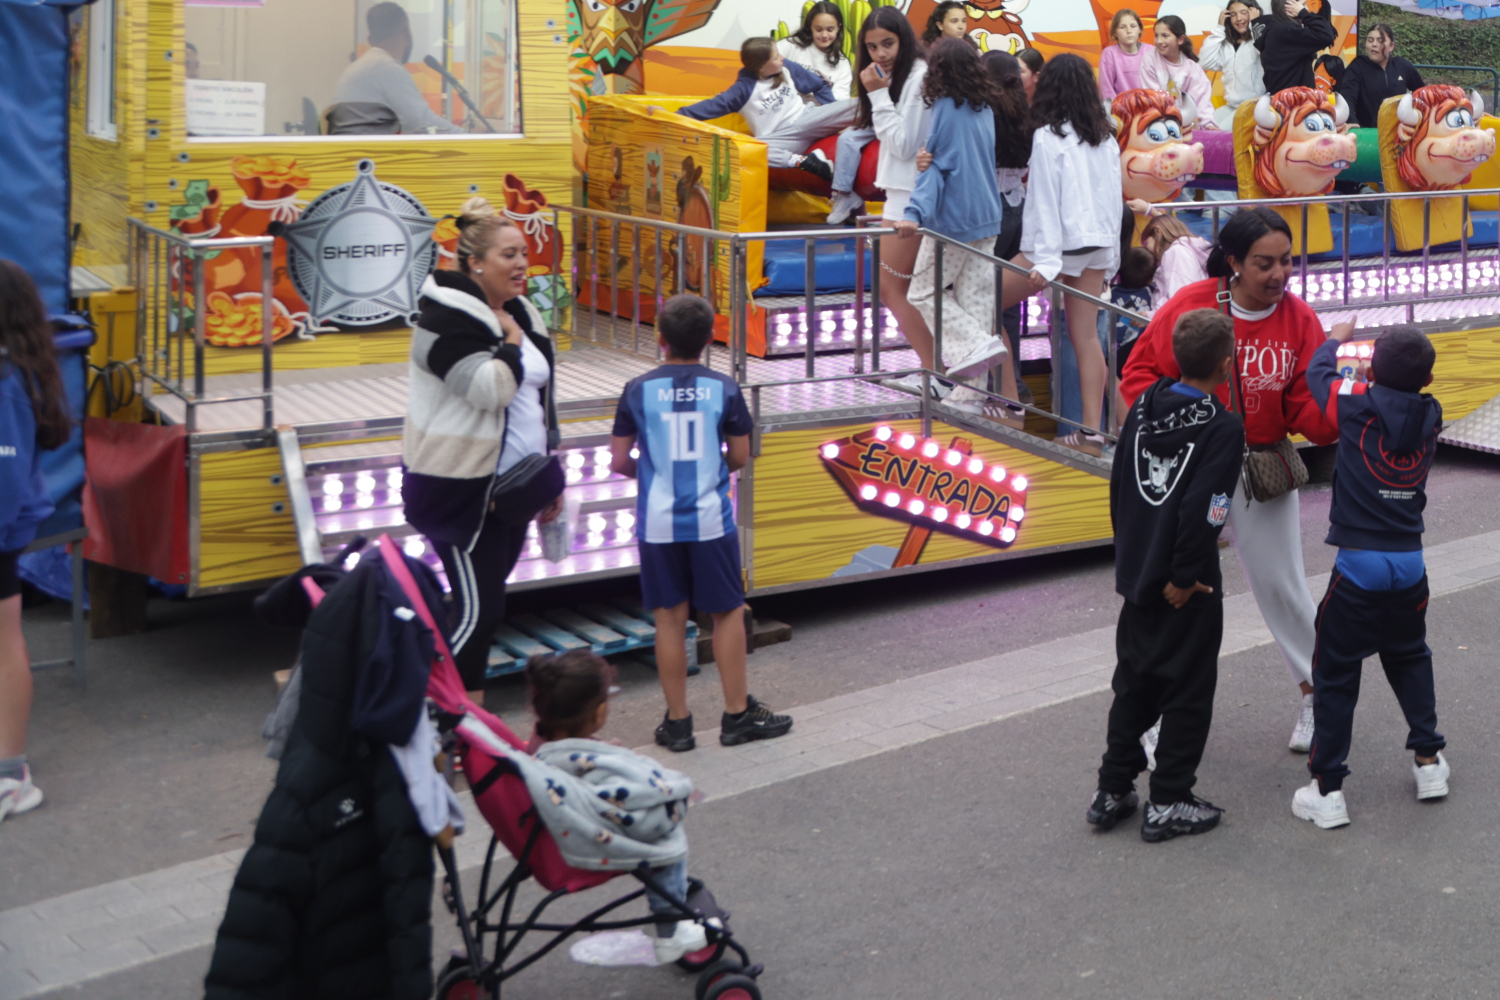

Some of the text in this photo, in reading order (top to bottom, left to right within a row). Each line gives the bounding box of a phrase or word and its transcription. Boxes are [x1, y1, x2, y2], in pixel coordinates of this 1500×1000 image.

[323, 244, 406, 260] SHERIFF
[658, 387, 711, 402] MESSI
[661, 411, 704, 460] 10
[859, 443, 1011, 527] ENTRADA
[1211, 506, 1226, 521] NFL
